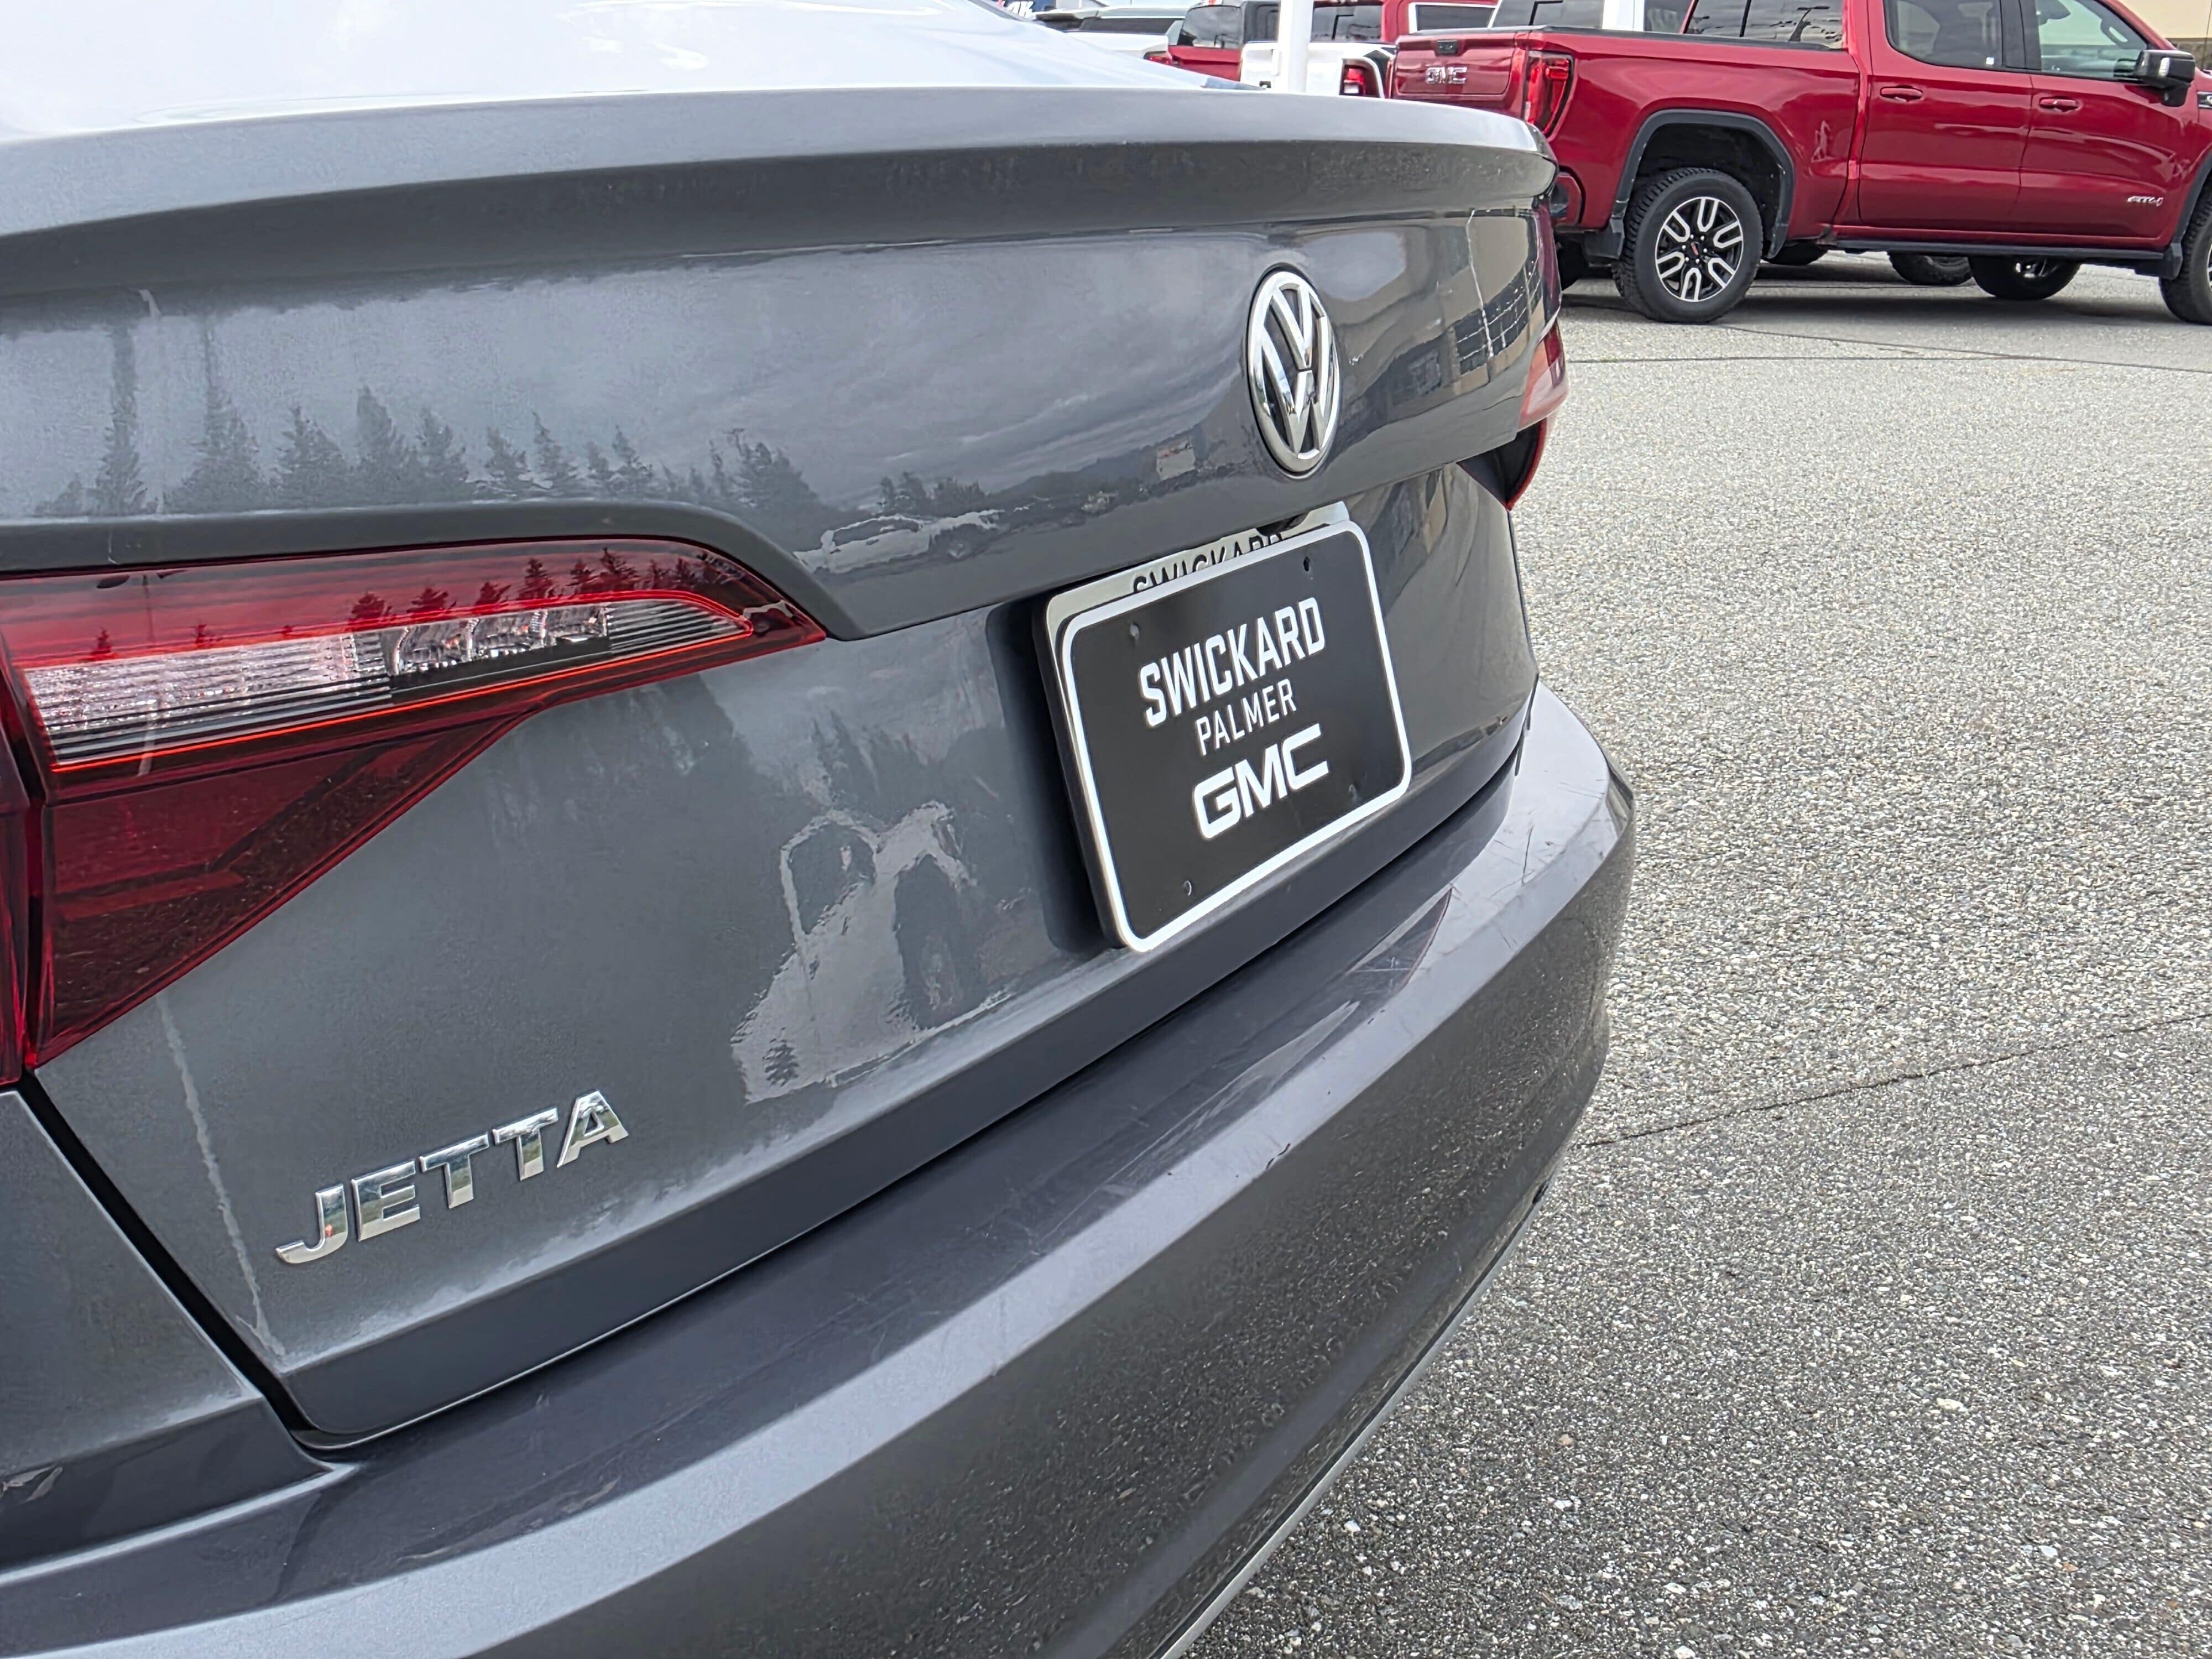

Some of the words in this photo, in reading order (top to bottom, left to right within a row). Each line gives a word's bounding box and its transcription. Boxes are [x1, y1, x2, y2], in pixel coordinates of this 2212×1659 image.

[1426, 66, 1468, 84] GMC
[1139, 597, 1325, 727] SWICKARD
[1195, 678, 1297, 756] PALMER
[1193, 722, 1329, 839] GMC
[276, 1089, 629, 1265] JETTA
